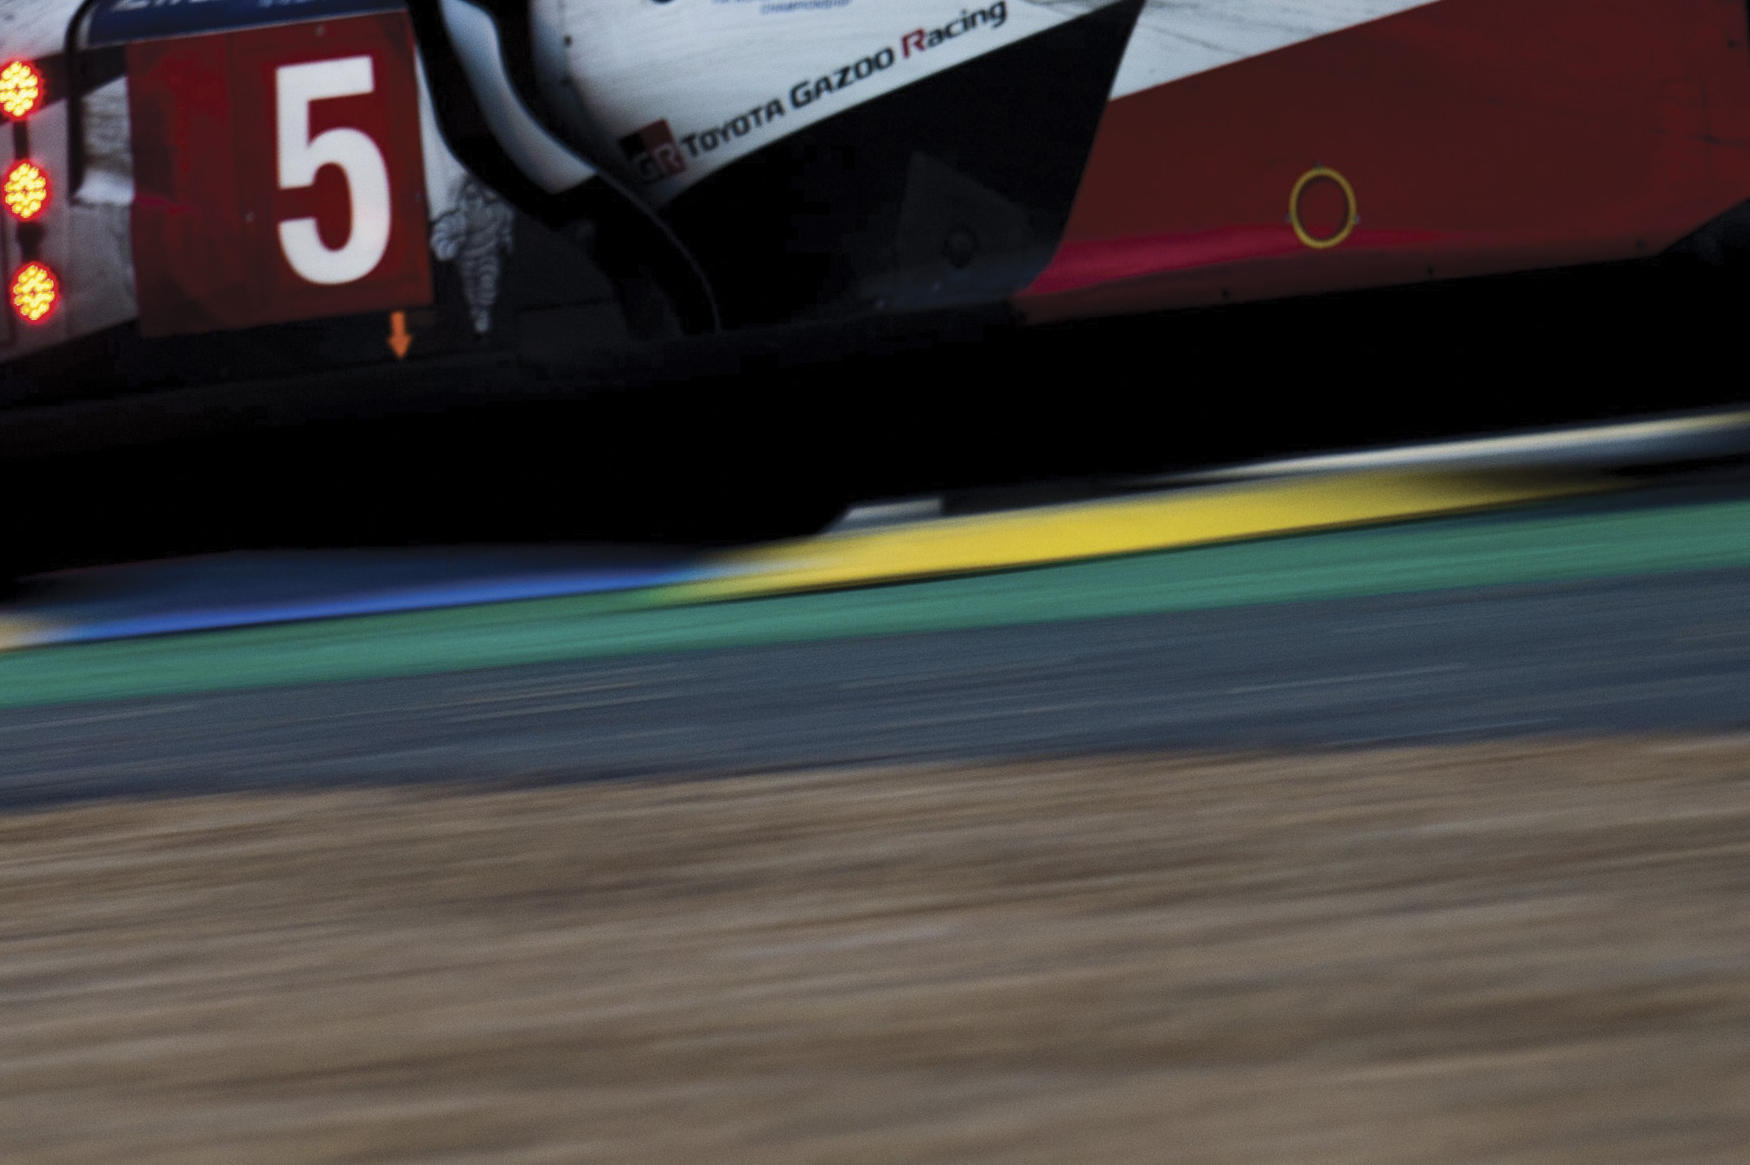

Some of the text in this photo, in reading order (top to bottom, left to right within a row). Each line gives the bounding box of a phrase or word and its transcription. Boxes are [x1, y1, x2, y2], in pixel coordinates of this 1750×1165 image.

[276, 55, 392, 286] 5
[681, 97, 786, 160] TOYOTA
[788, 47, 896, 110] GAZOO
[900, 0, 1009, 59] Racing
